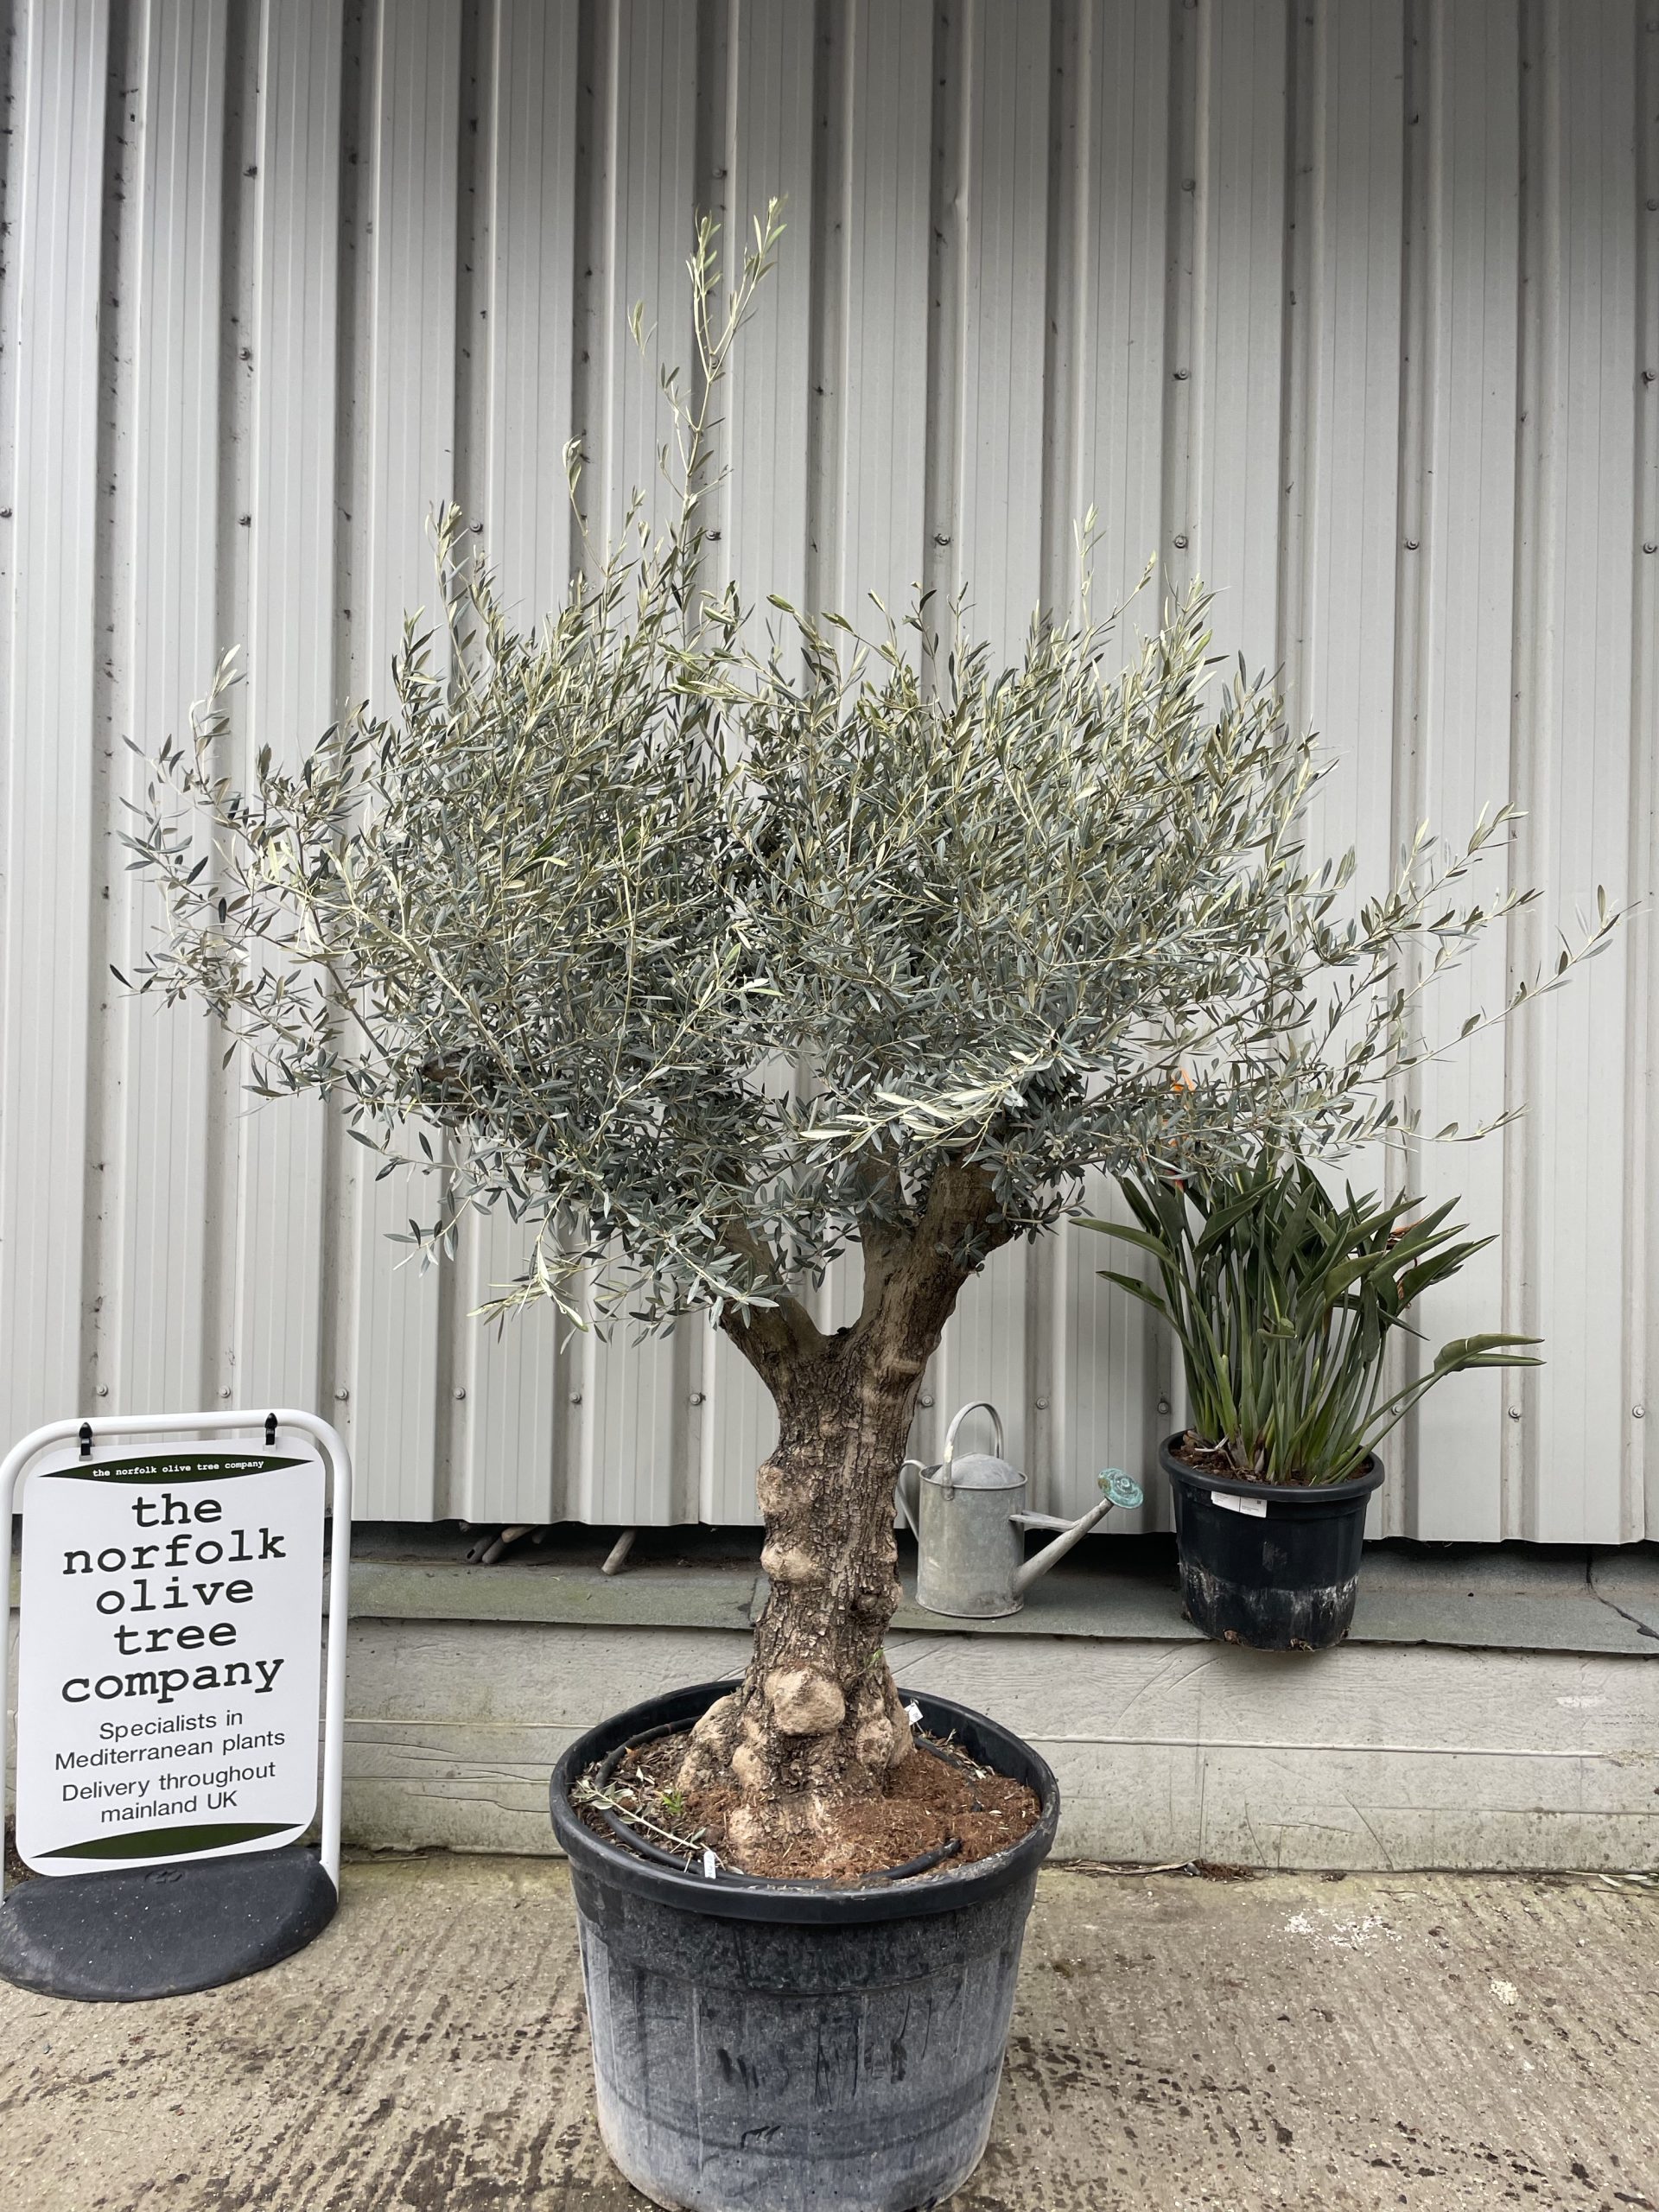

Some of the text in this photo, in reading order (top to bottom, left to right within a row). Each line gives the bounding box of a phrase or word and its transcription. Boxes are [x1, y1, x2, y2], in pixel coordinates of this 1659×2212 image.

[92, 1469, 111, 1478] the
[115, 1465, 157, 1476] norfolk
[162, 1464, 192, 1473] olive
[224, 1459, 264, 1470] company
[132, 1493, 221, 1527] the
[63, 1528, 286, 1574] norfolk
[97, 1577, 252, 1614] olive
[114, 1623, 236, 1655] tree
[62, 1659, 284, 1703] company
[99, 1710, 243, 1743] Specialists in
[55, 1732, 285, 1770] Mediterranean plants
[62, 1762, 276, 1802] Delivery throughout
[101, 1790, 238, 1823] mainland UK
